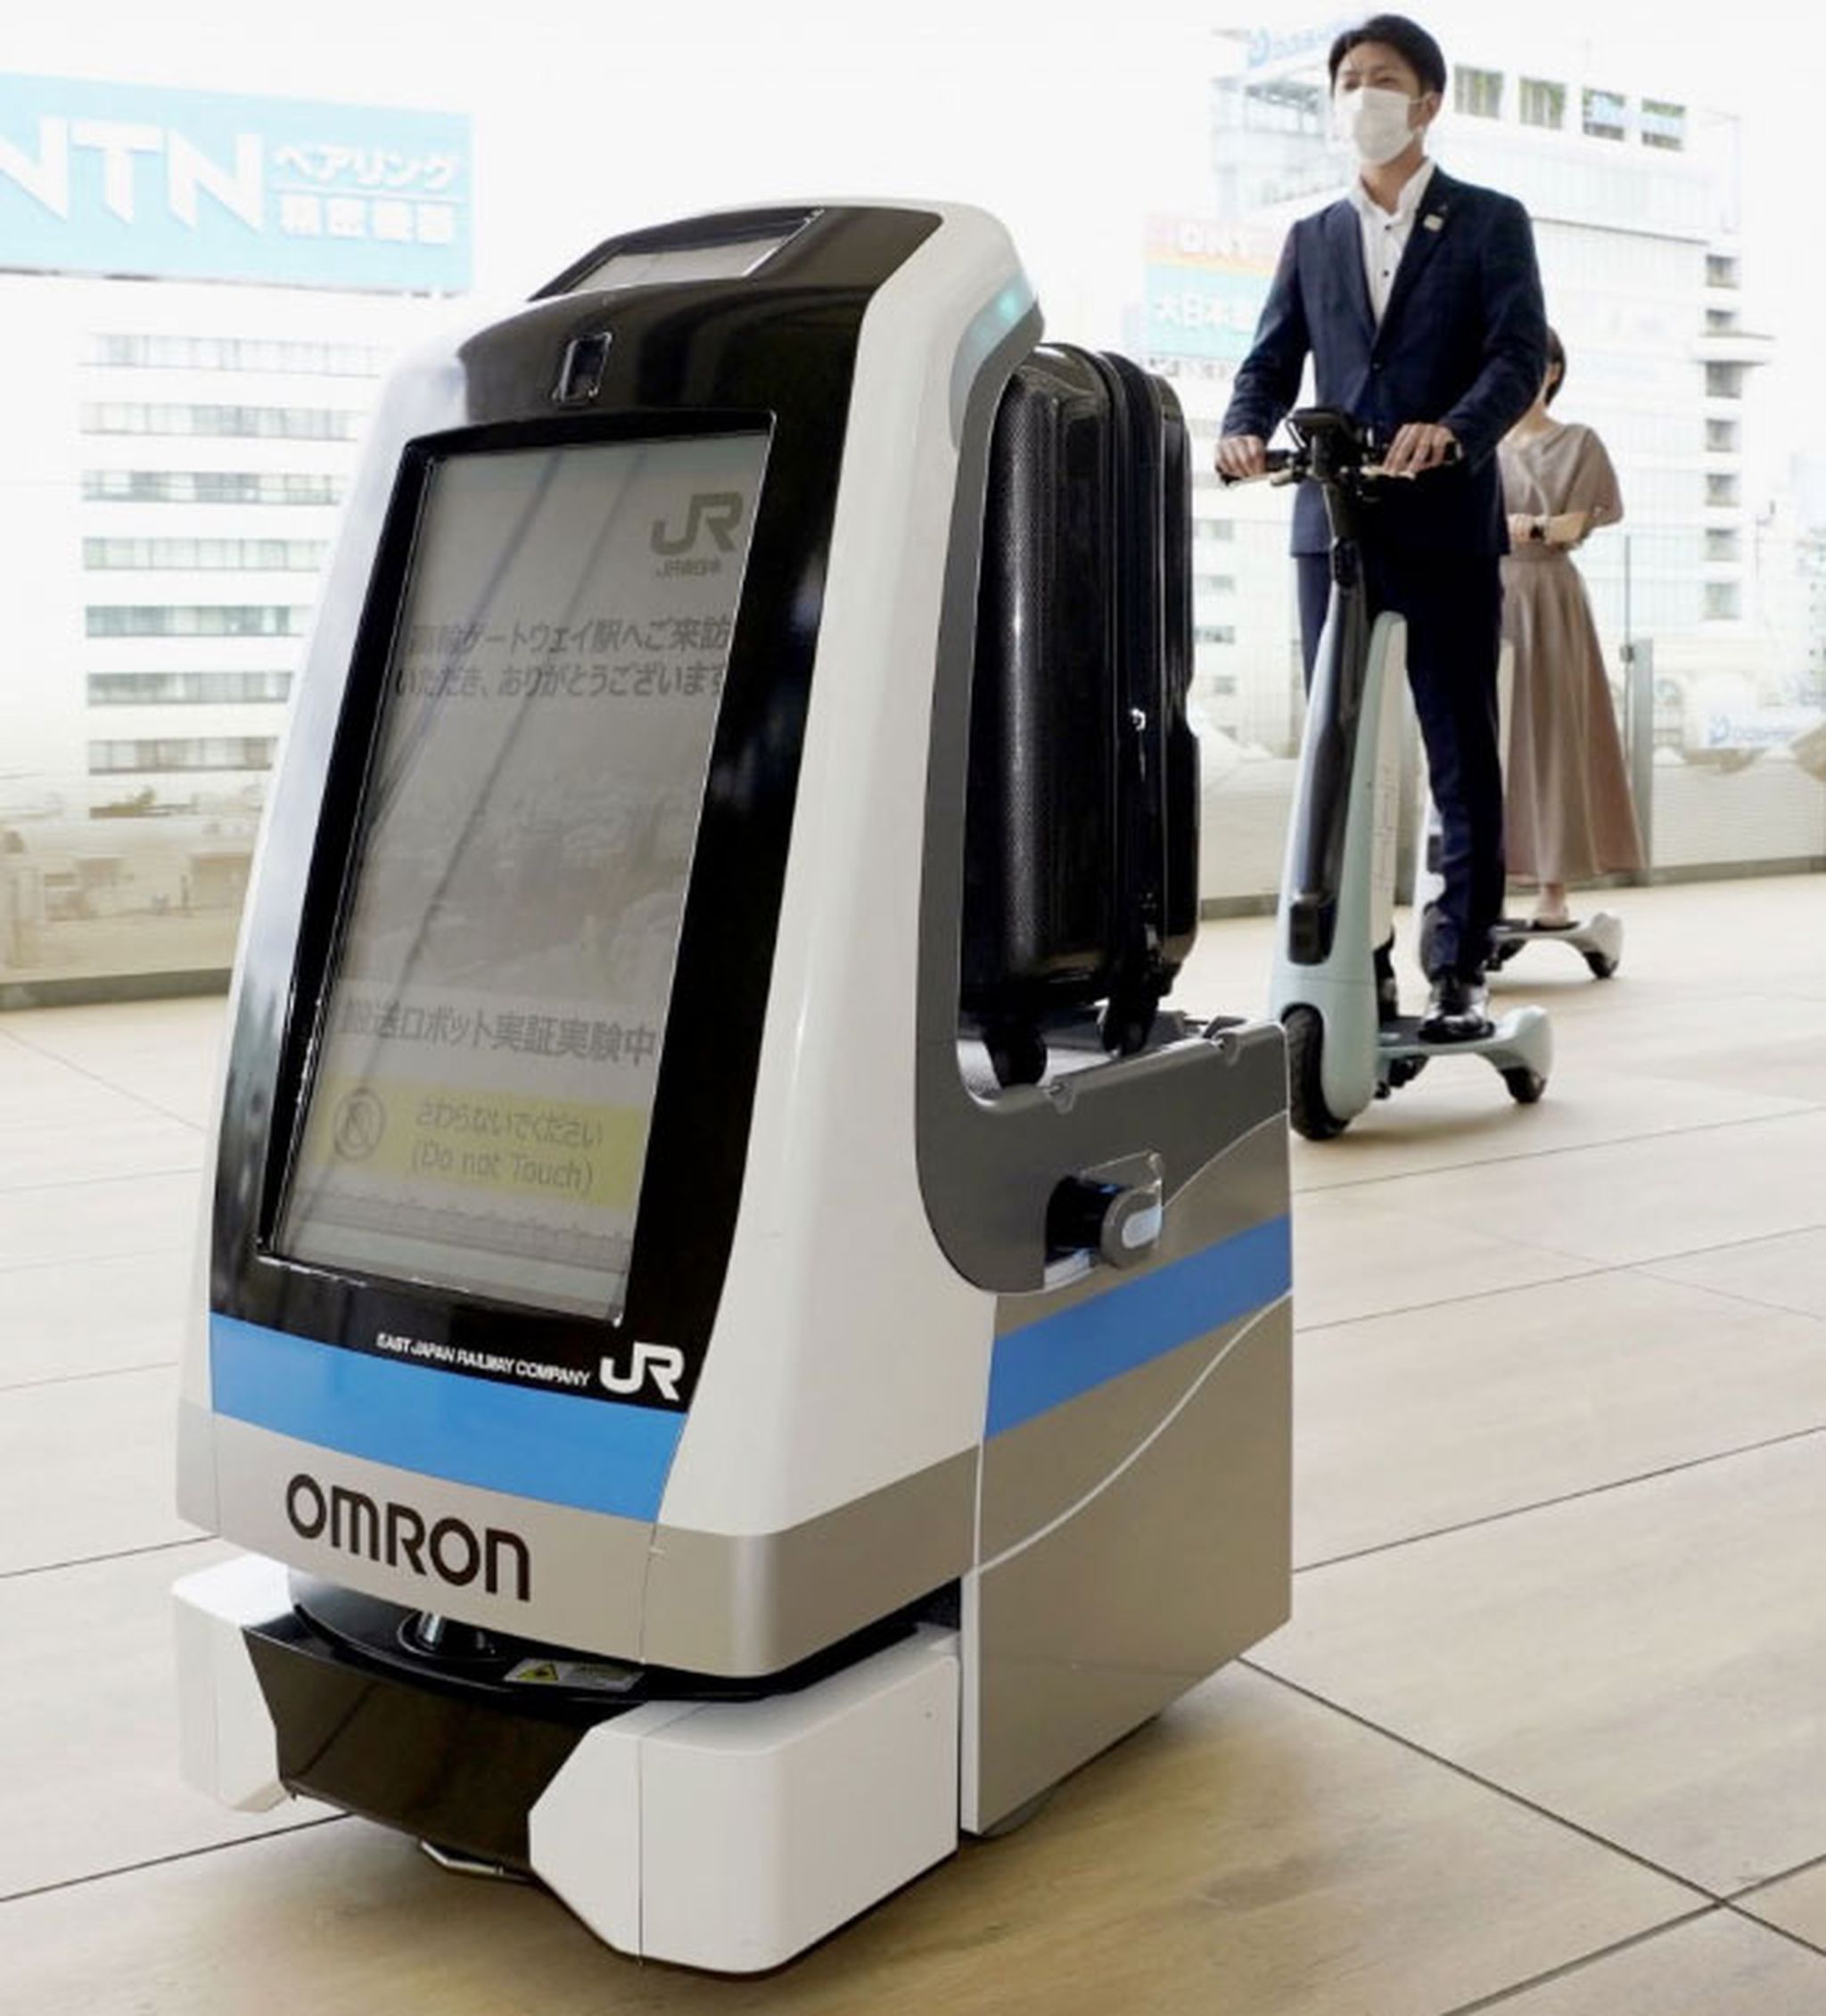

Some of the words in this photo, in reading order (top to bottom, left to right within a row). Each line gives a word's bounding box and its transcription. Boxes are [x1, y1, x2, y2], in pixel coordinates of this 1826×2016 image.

[0, 116, 265, 235] NTN
[651, 492, 744, 555] JR
[411, 1139, 454, 1173] (Do
[462, 1149, 501, 1177] not
[513, 1151, 595, 1197] Touch)
[376, 1332, 410, 1354] EAST
[411, 1341, 456, 1363] JAPAN
[456, 1348, 515, 1375] RAILWAY
[516, 1360, 591, 1387] COMPANY
[599, 1340, 685, 1401] JR
[285, 1473, 531, 1602] OMRON
